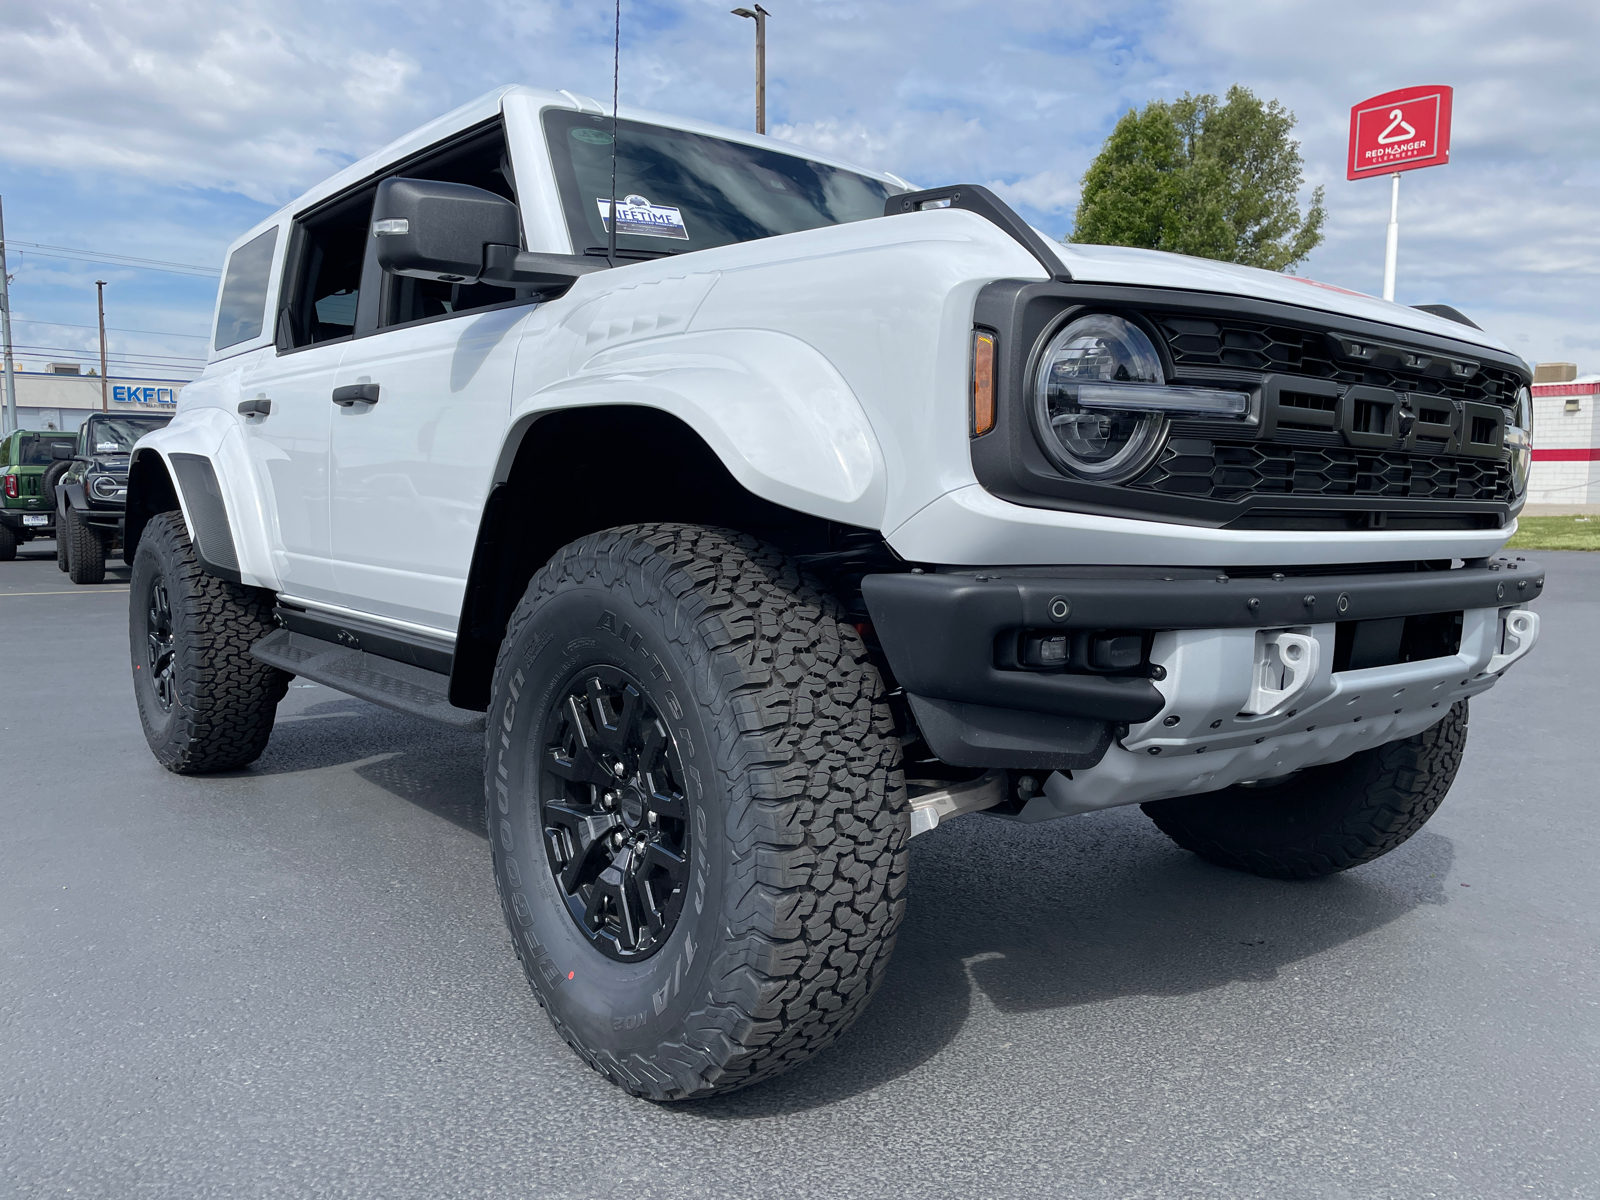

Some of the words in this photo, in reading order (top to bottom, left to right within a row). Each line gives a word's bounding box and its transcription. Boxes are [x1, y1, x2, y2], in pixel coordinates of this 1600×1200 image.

[1365, 149, 1384, 159] RED
[1385, 140, 1427, 154] HANGER
[1372, 150, 1418, 163] CLEANERS
[615, 209, 673, 224] IFETIME
[1257, 373, 1505, 459] FORD
